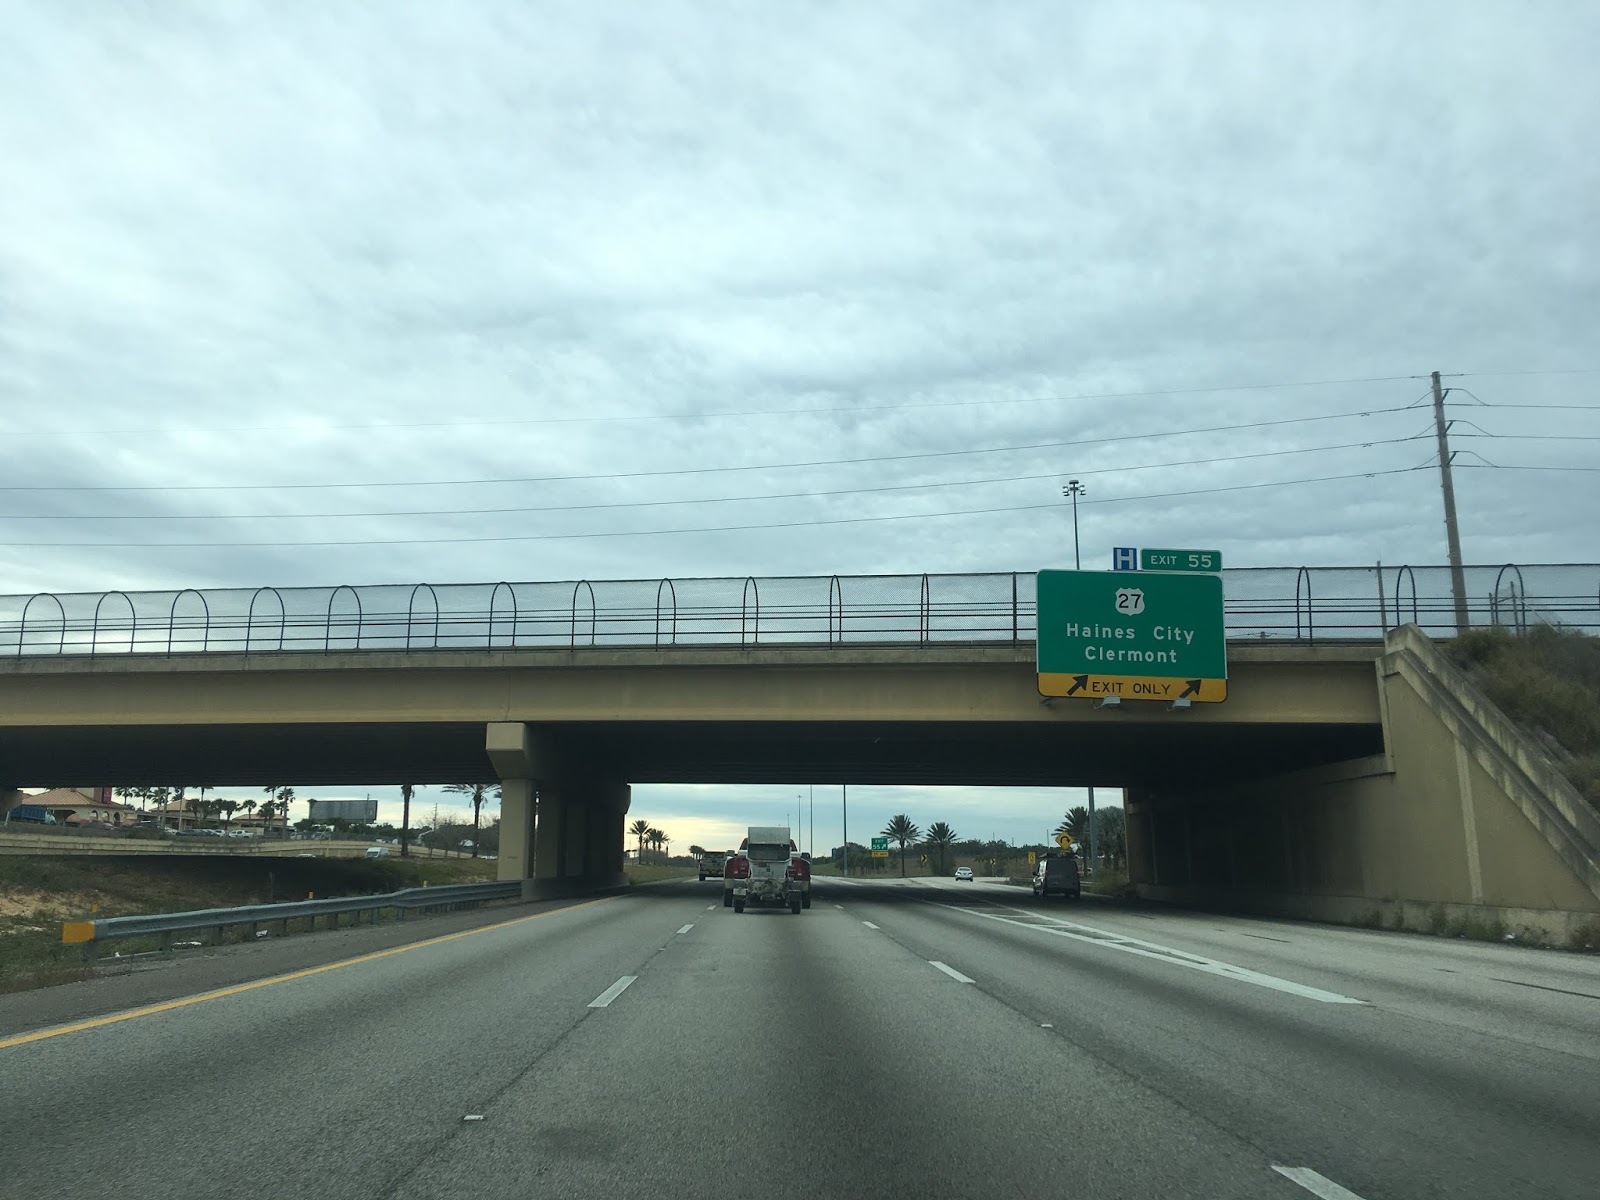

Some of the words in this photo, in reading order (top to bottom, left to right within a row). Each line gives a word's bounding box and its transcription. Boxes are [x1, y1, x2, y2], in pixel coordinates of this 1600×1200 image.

[1116, 548, 1134, 570] H
[1150, 555, 1177, 565] EXIT
[1188, 554, 1212, 568] 55
[1118, 593, 1142, 609] 27
[1066, 623, 1136, 639] Haines
[1153, 626, 1195, 645] City
[1085, 645, 1178, 663] Clermont
[1092, 681, 1124, 693] EXIT
[1133, 683, 1171, 695] ONLY
